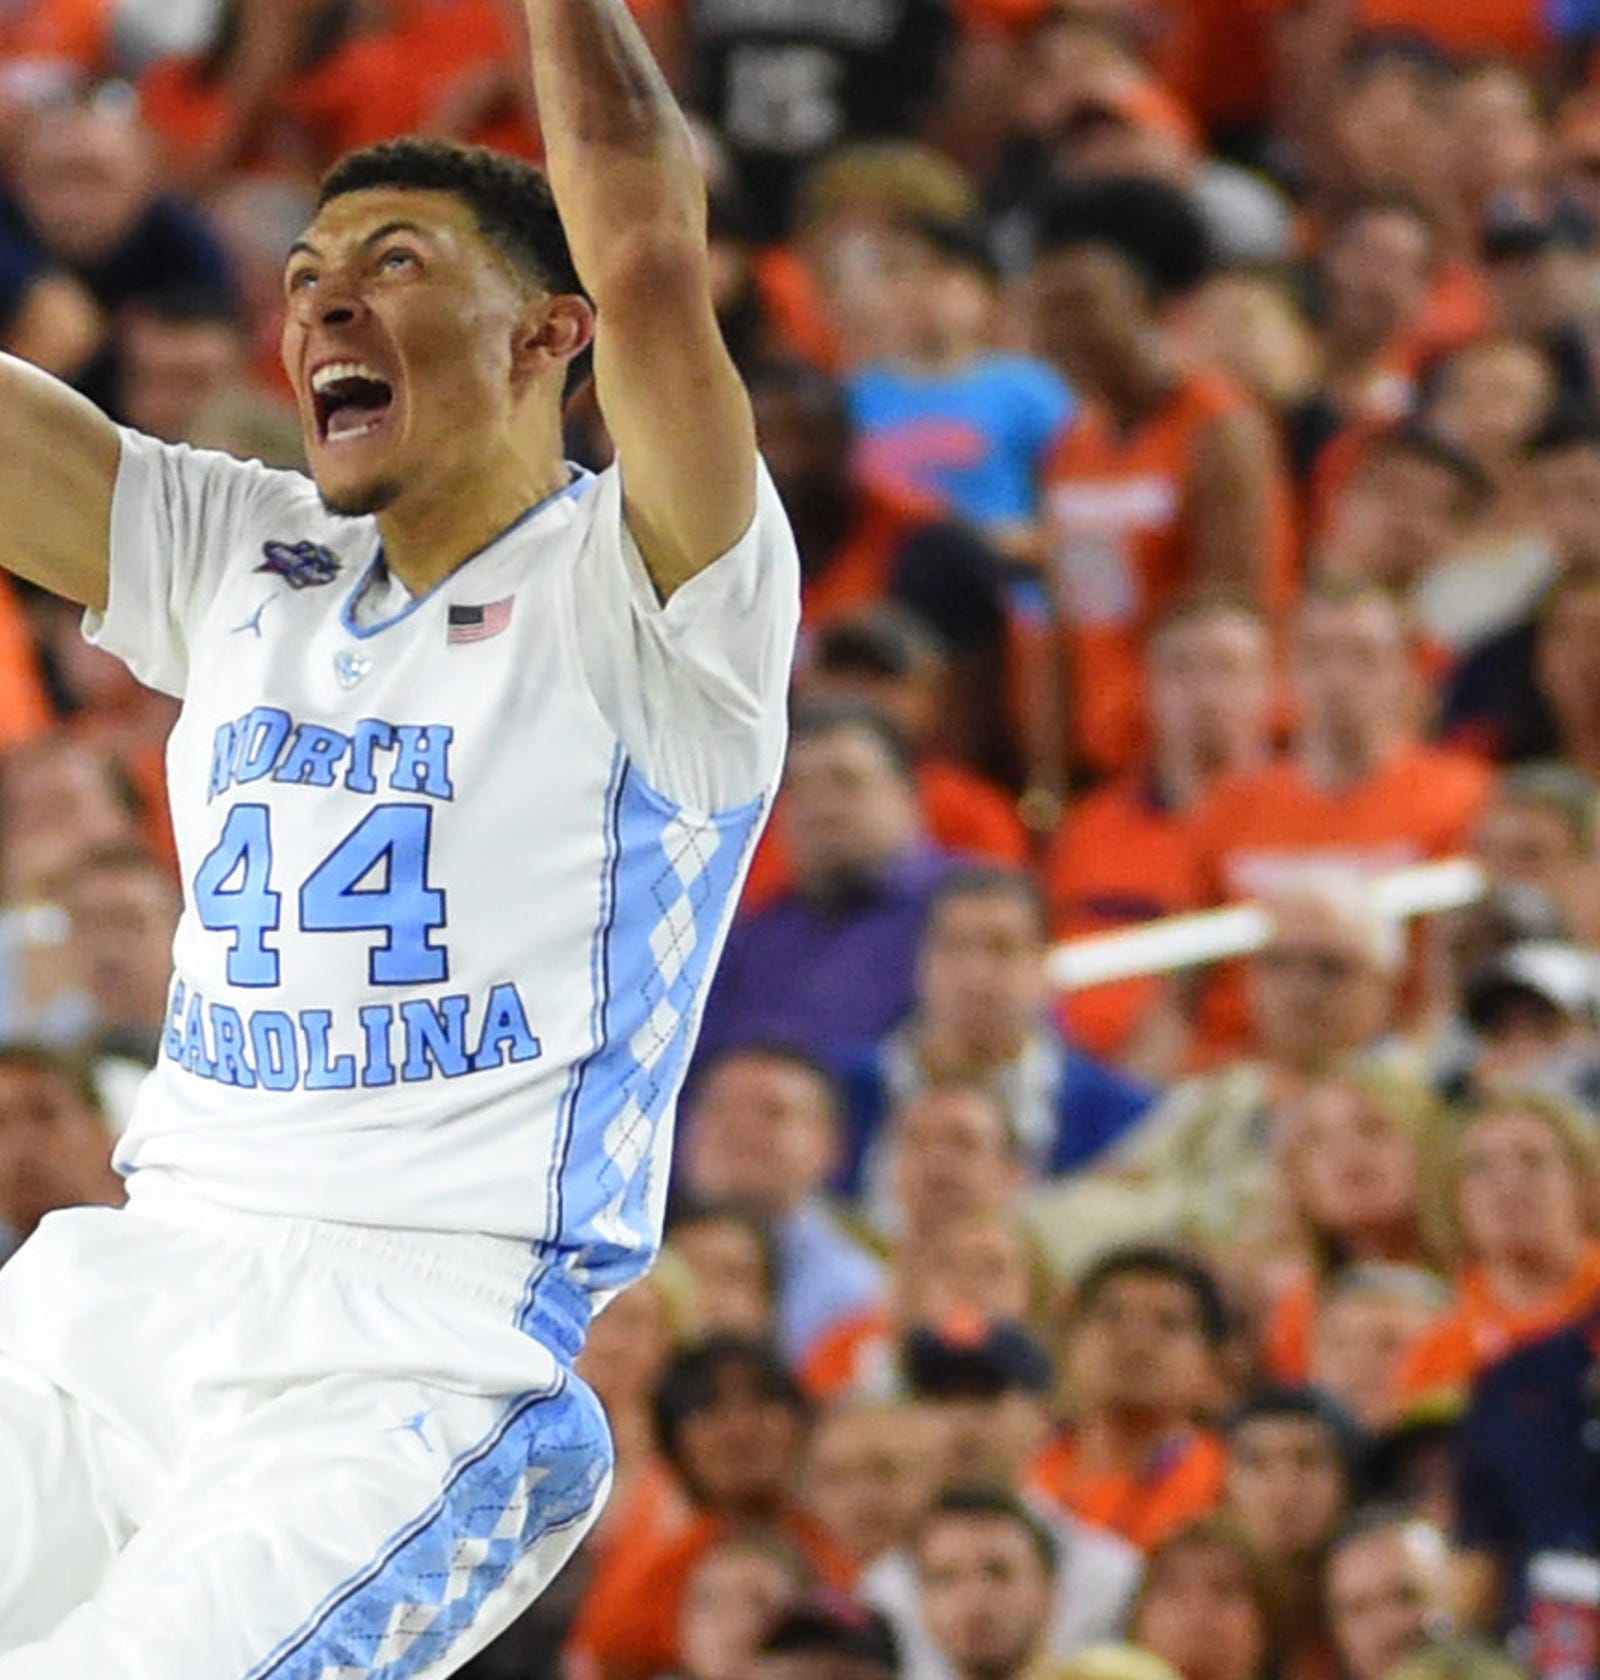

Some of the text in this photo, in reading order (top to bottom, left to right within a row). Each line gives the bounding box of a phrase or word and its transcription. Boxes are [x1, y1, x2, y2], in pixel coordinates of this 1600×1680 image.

[208, 706, 454, 804] NORTH
[193, 803, 449, 987] 44
[165, 979, 542, 1091] CAROLINA
